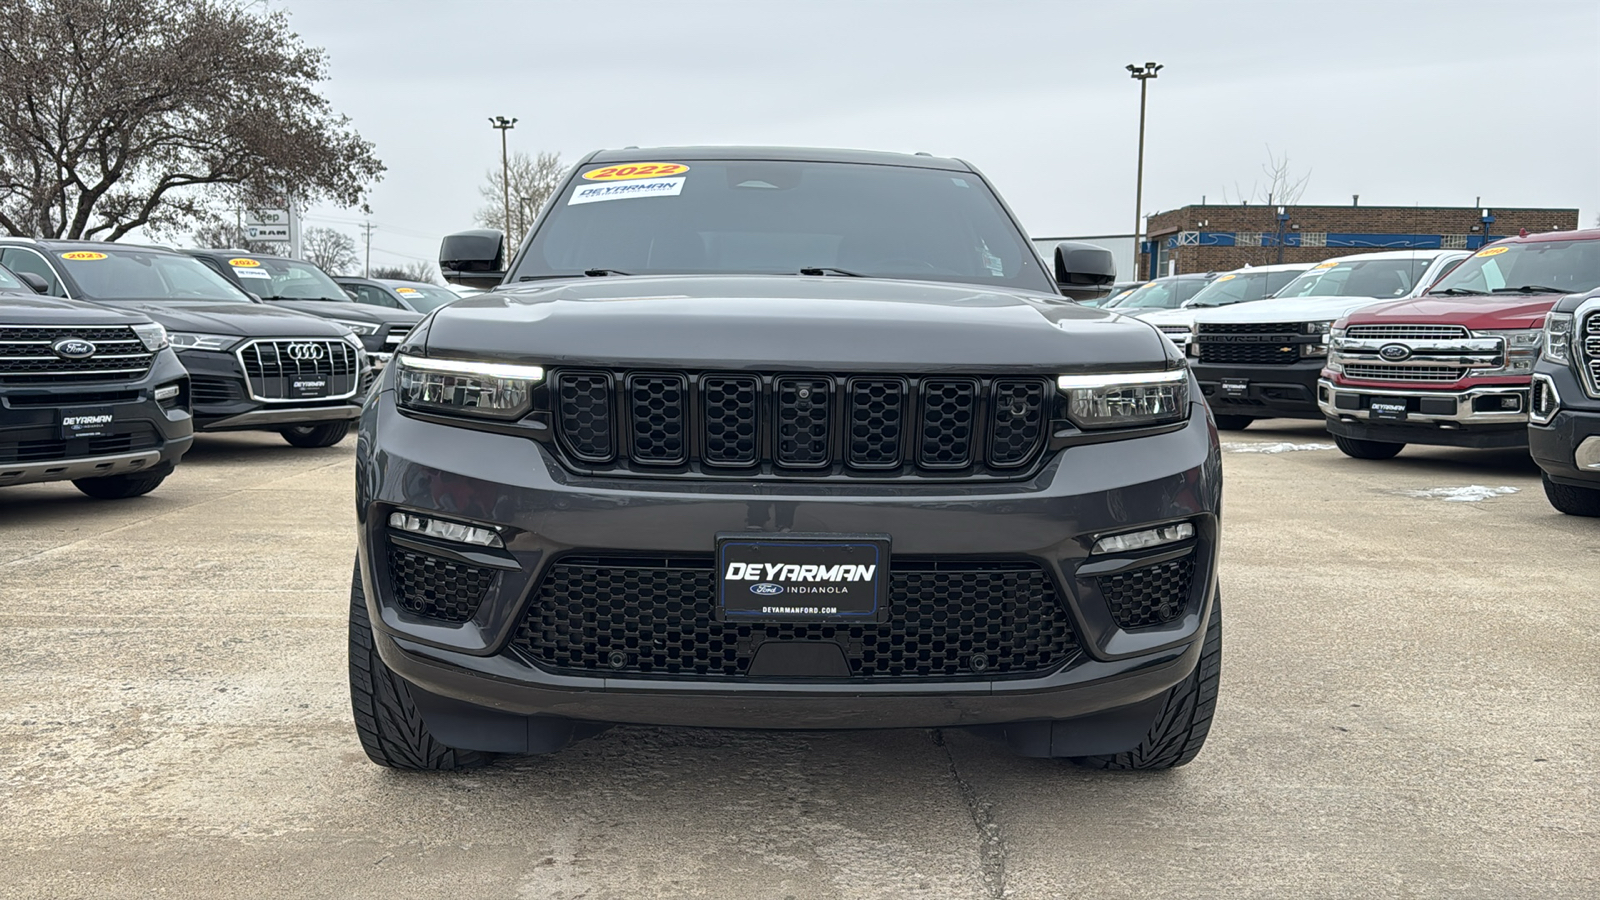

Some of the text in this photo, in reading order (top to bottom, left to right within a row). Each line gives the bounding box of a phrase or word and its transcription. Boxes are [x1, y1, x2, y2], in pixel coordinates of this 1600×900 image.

[593, 165, 680, 179] 2022
[581, 183, 677, 196] DEYARMAN
[1198, 335, 1295, 343] CHEVROLET
[66, 343, 88, 354] Ford
[63, 414, 113, 426] DEYARMAN
[725, 562, 876, 582] DEYARMAN
[756, 585, 849, 594] Ford INDIANOLA
[762, 606, 837, 614] DEYARMANFORD.COM
